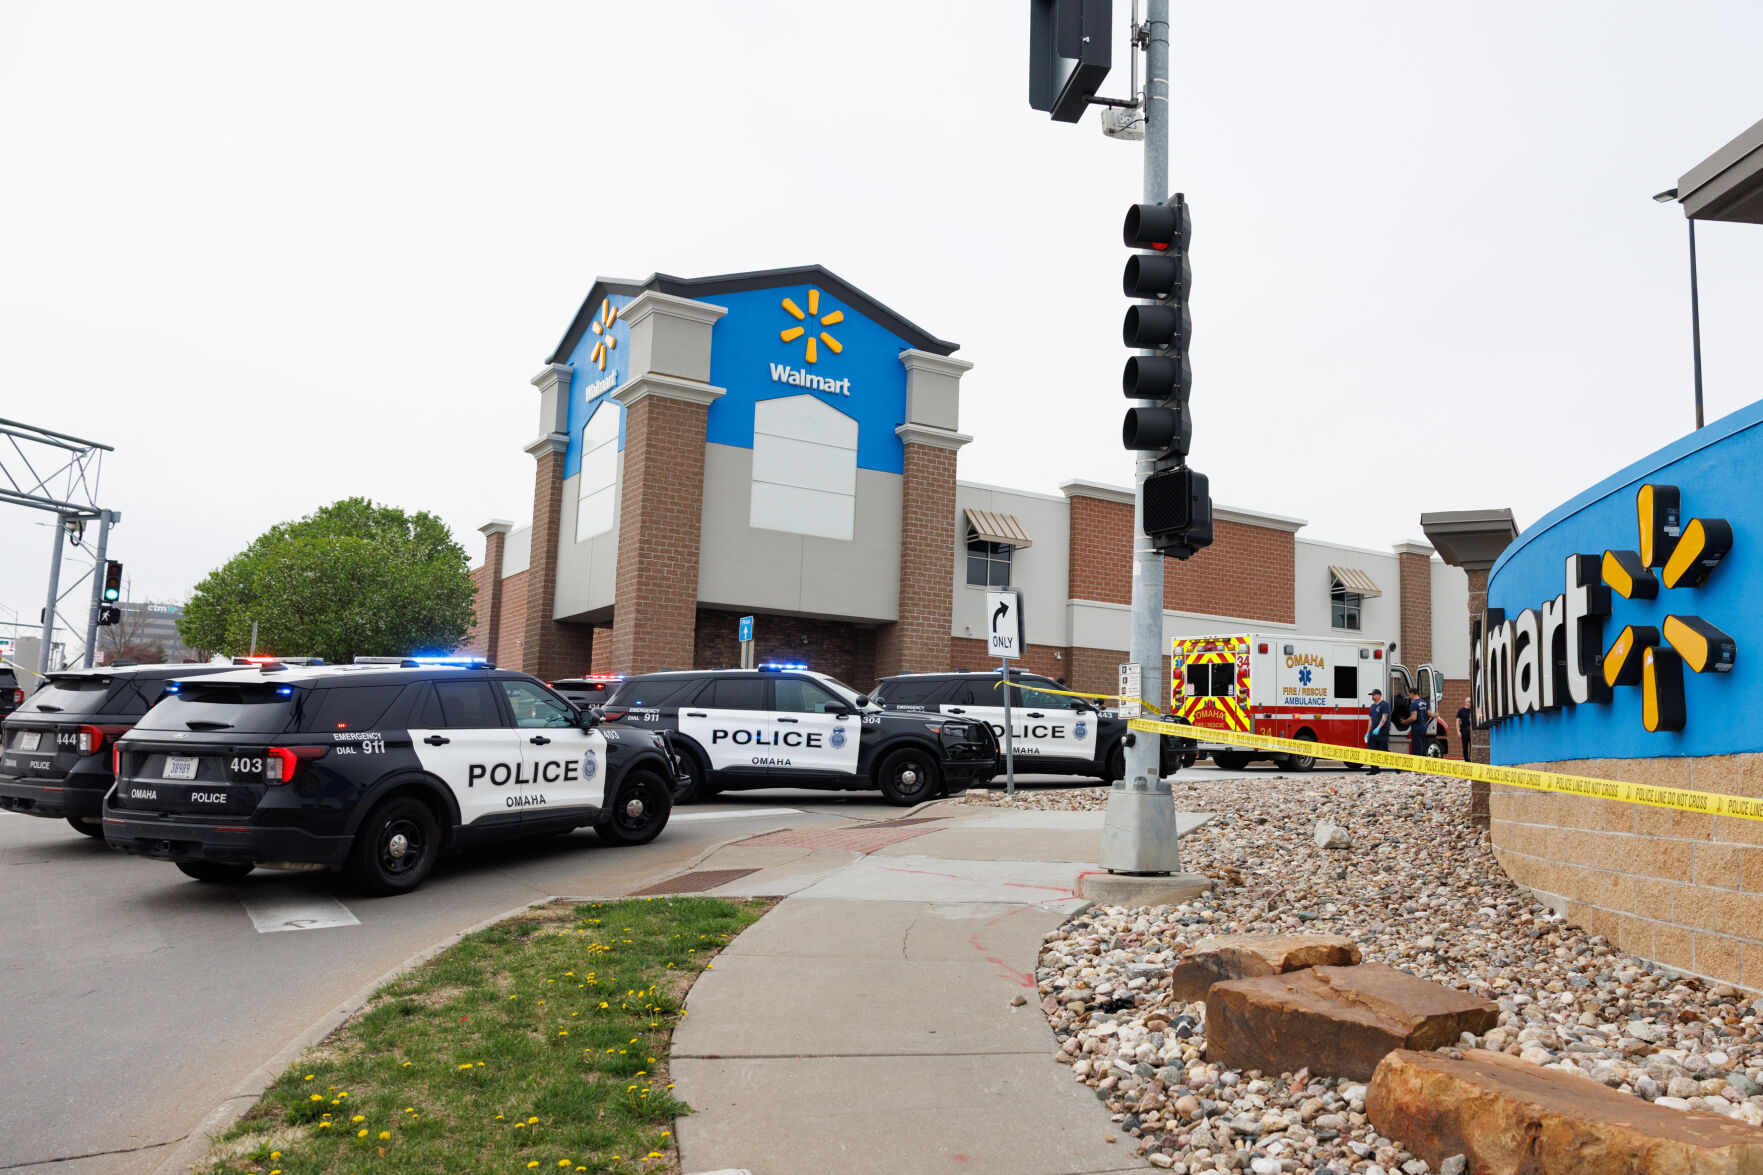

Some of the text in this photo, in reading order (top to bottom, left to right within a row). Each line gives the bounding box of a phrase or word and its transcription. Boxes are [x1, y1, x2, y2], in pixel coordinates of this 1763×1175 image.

[769, 362, 851, 396] Walmart
[992, 635, 1013, 649] ONLY
[1472, 553, 1588, 727] almart
[1236, 655, 1250, 669] 34
[1285, 653, 1325, 669] OMAHA
[1282, 686, 1297, 696] FIRE
[1301, 687, 1328, 697] RESCUE
[1284, 696, 1326, 706] AMBULANCE
[643, 713, 660, 722] 911
[862, 716, 881, 724] 304
[1195, 709, 1224, 720] OMAHA
[333, 732, 382, 741] EMERGENCY
[603, 730, 619, 740] 403
[991, 724, 1065, 739] OLICE
[1260, 727, 1272, 737] 34
[56, 733, 77, 745] 444
[712, 729, 823, 748] POLICE
[336, 740, 386, 755] DIAL 911
[1012, 746, 1040, 754] MAHA
[29, 760, 50, 770] POLICE
[230, 757, 263, 773] 403
[751, 756, 791, 766] OMAHA
[468, 760, 579, 788] POLICE
[1556, 776, 1618, 797] POLICE LINE DO NOT CROSS
[131, 788, 157, 800] OMAHA
[191, 792, 227, 803] POLICE
[1636, 787, 1708, 810] POLICE LINE DO NOT CROSS
[506, 794, 547, 808] OMAHA
[1728, 799, 1763, 818] POLICE LINE
